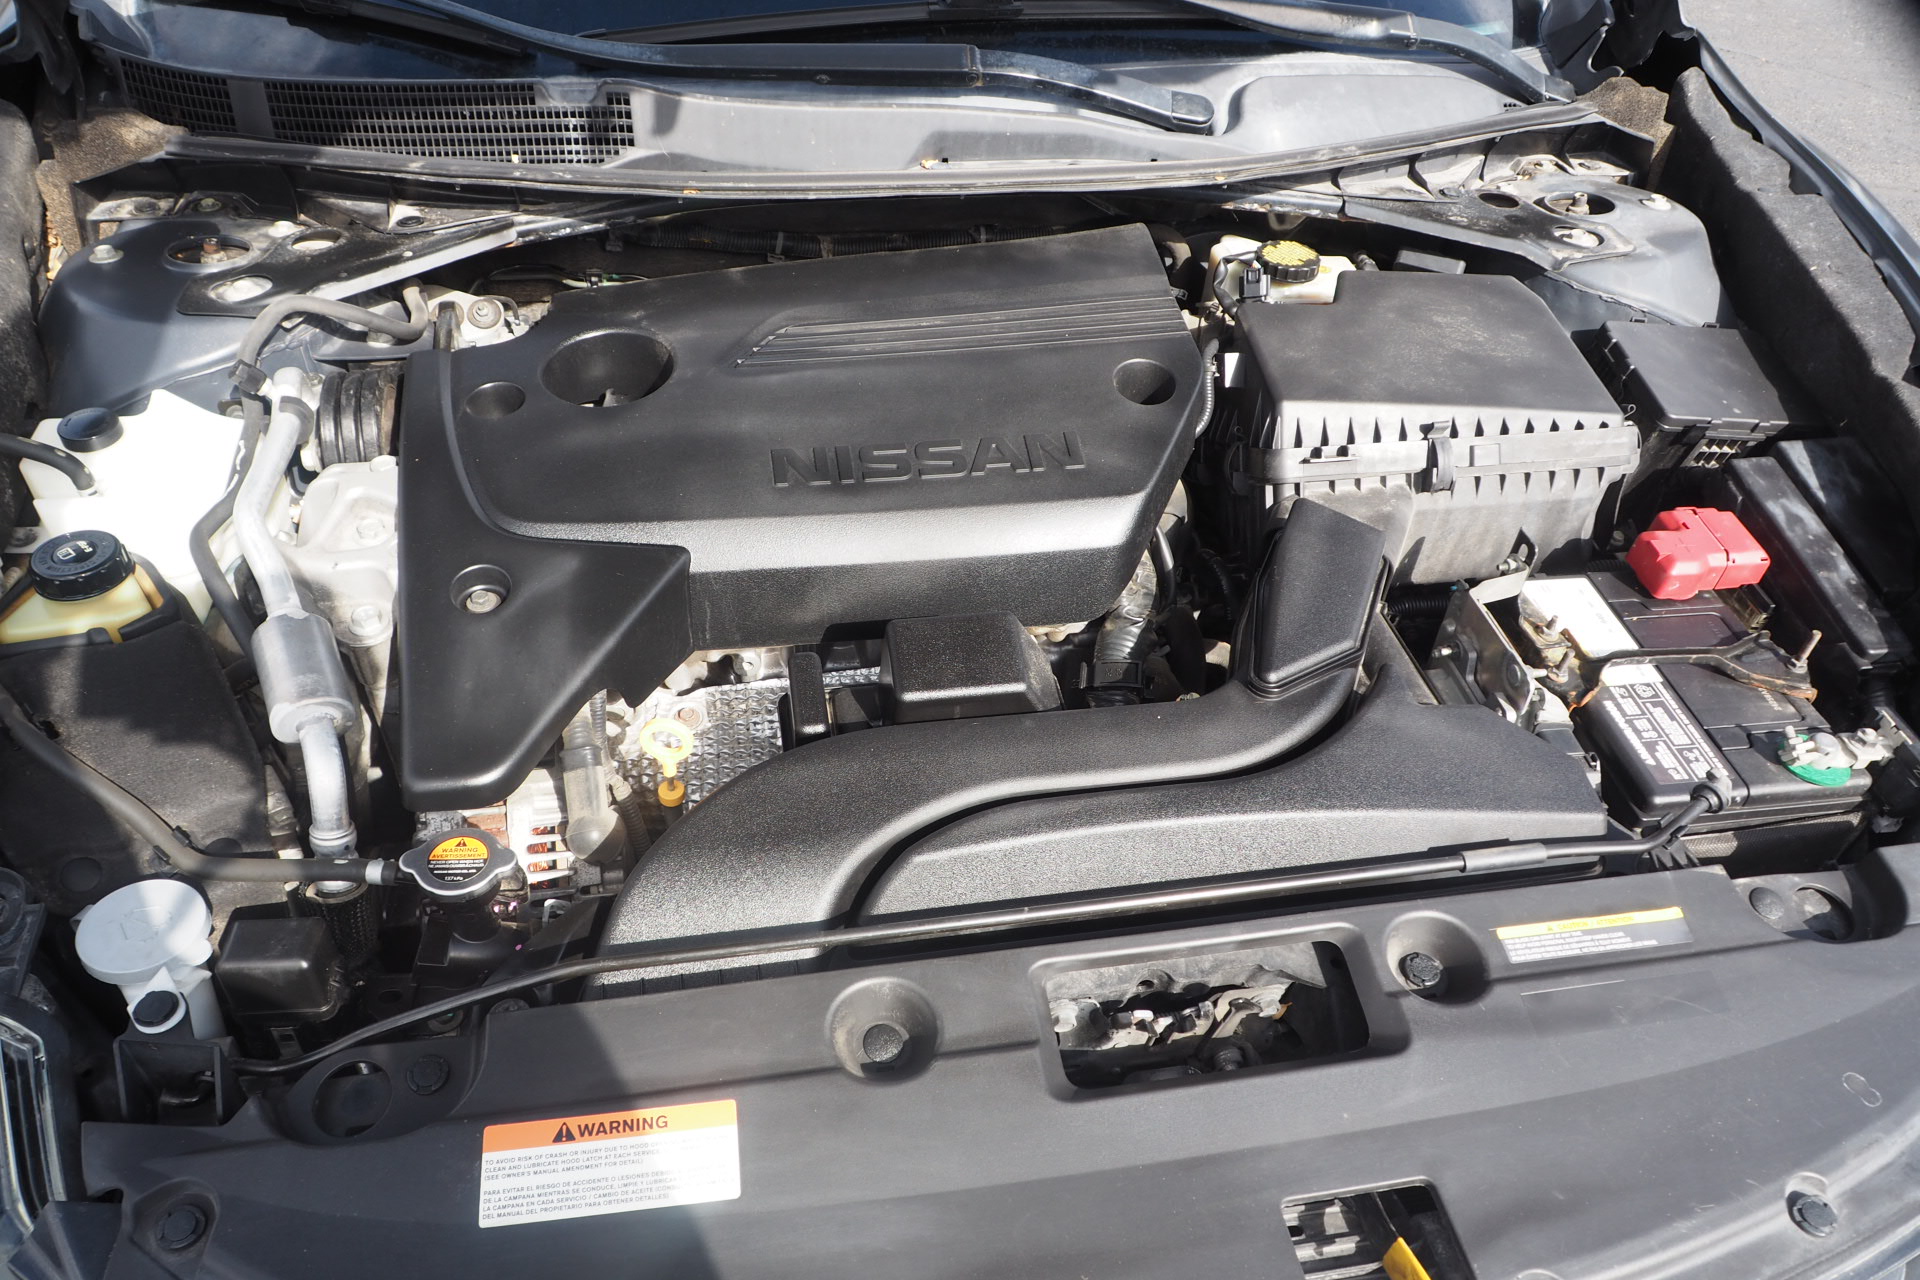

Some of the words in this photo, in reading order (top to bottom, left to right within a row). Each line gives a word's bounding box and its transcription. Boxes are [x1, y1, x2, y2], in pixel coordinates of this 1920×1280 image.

[770, 432, 1085, 487] NISSAN
[577, 1115, 668, 1138] WARNING
[524, 1160, 558, 1168] LUBRICATE
[634, 1149, 660, 1157] SERVICE
[501, 1171, 531, 1179] OWNER'S
[562, 1163, 602, 1172] AMENDMENT
[573, 1177, 609, 1186] ACCIDENTE
[618, 1173, 650, 1181] LESIONES
[537, 1190, 570, 1198] MIENTRAS
[582, 1184, 614, 1193] CONDUCE,
[618, 1181, 638, 1189] LIMPIE
[497, 1210, 523, 1218] MANUAL
[540, 1203, 582, 1213] PROPIETARIO
[603, 1197, 633, 1205] OBTENER
[635, 1193, 669, 1202] DETALLES)
[556, 1195, 586, 1203] SERVICIO
